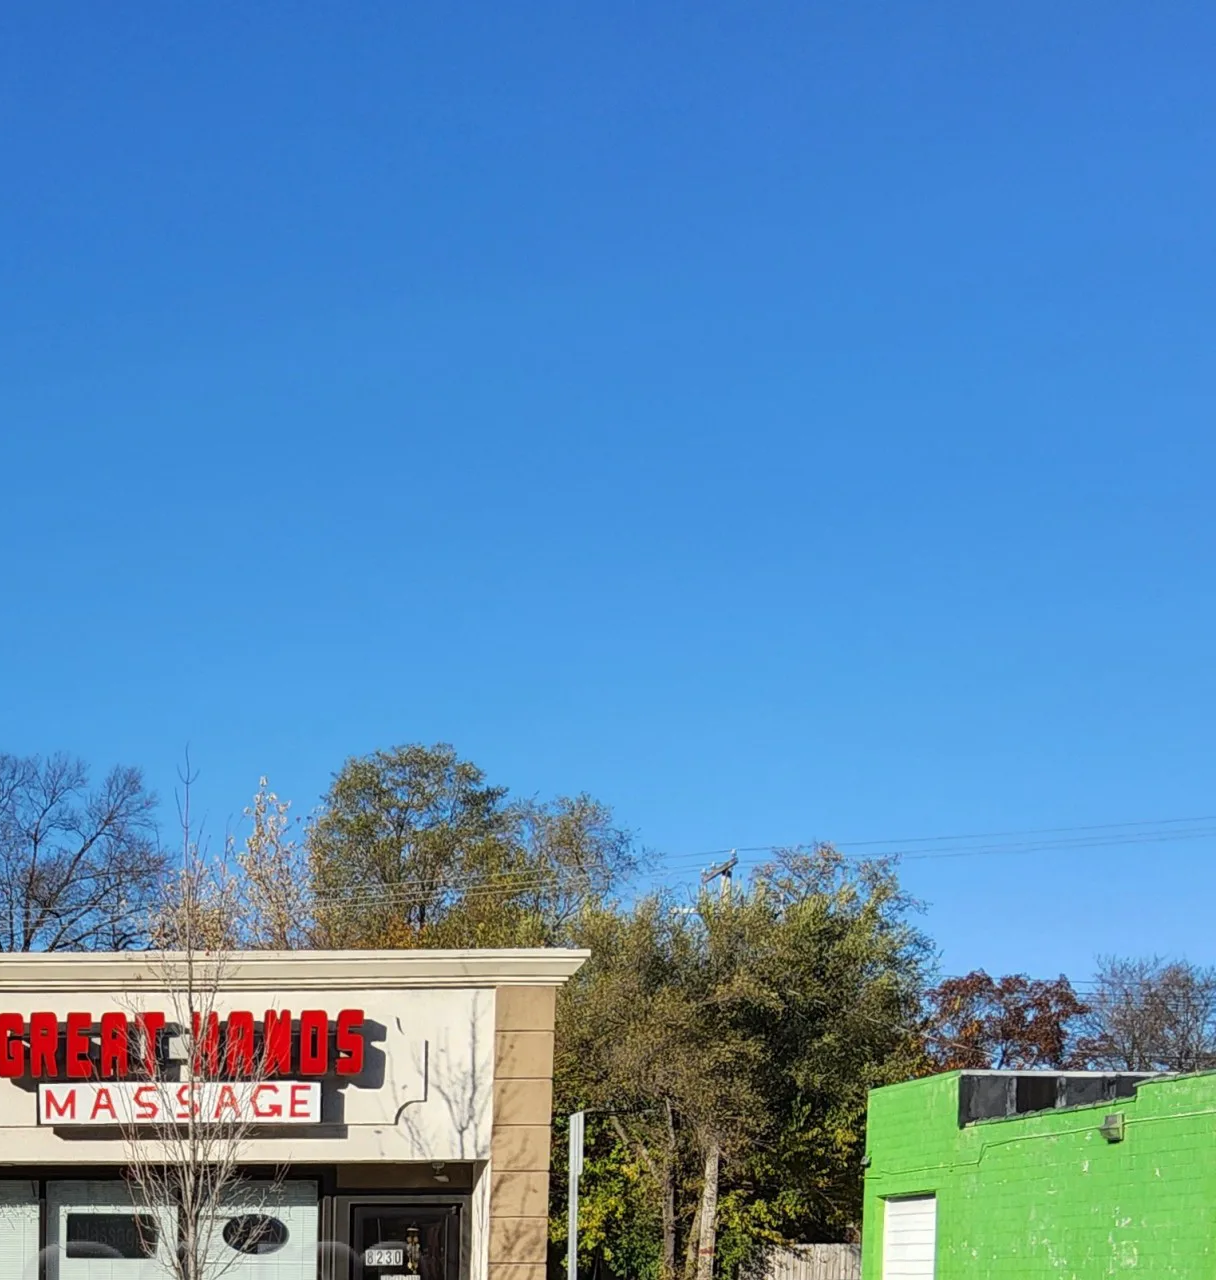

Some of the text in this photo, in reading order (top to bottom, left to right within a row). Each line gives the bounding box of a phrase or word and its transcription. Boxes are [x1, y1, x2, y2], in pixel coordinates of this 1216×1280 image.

[192, 1009, 365, 1075] HANDS
[45, 1084, 313, 1120] MASSAGE
[366, 1250, 402, 1265] 8230
